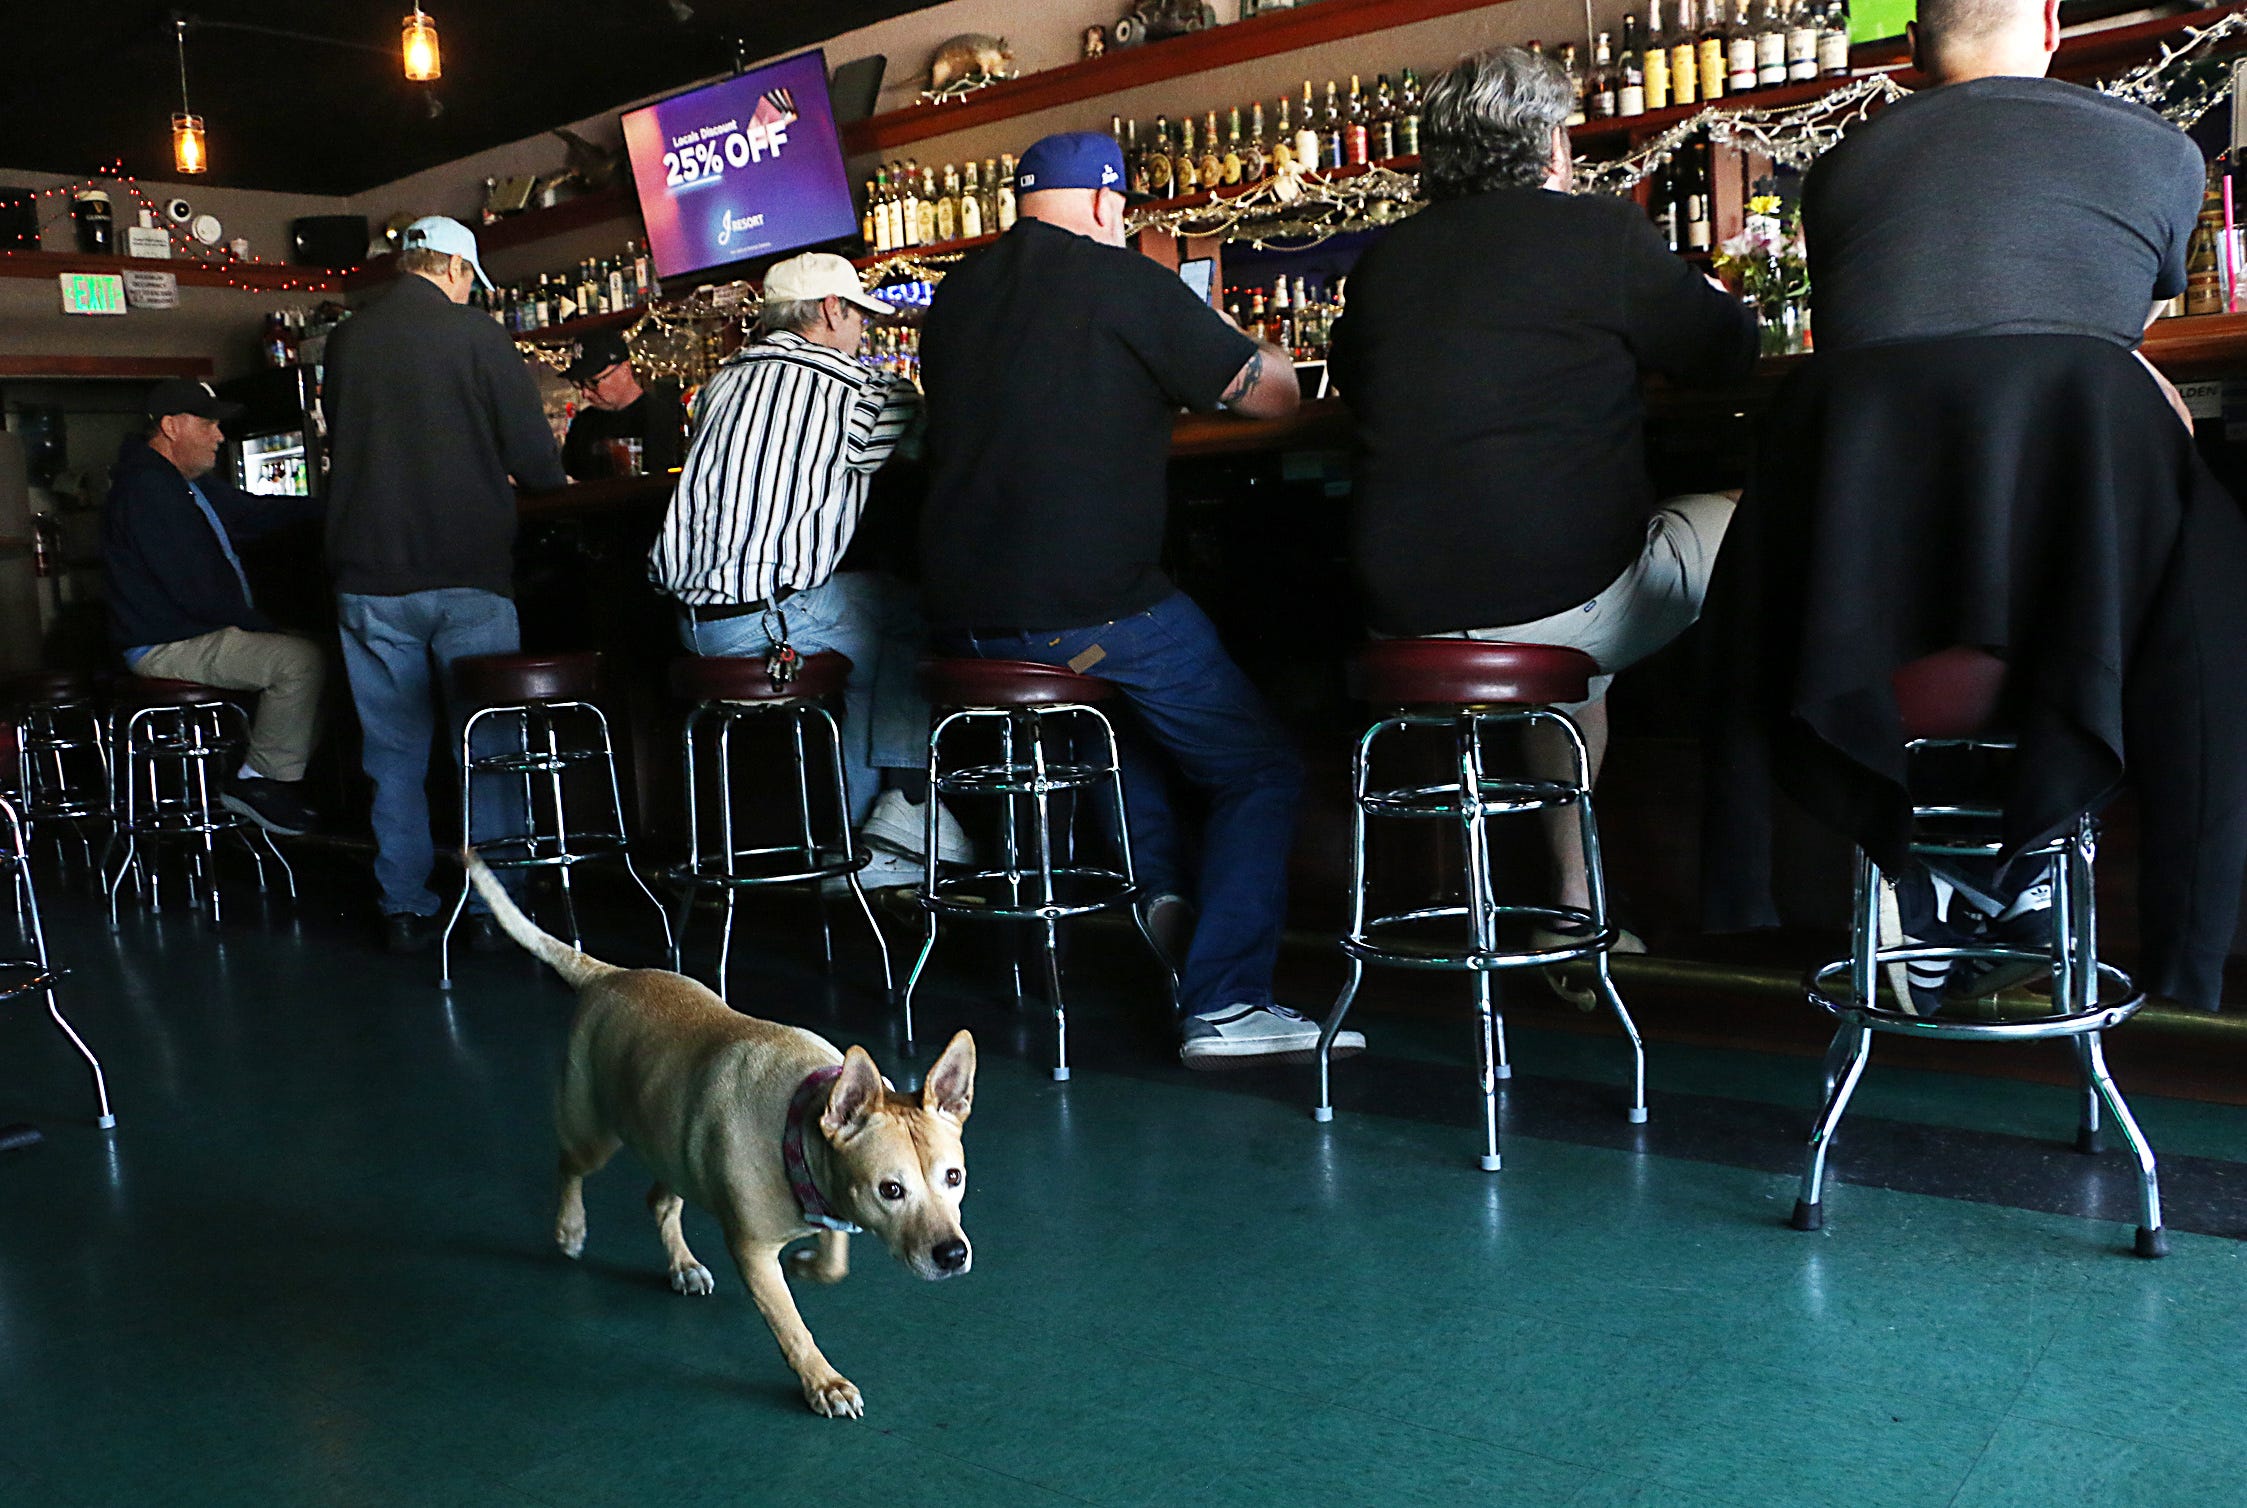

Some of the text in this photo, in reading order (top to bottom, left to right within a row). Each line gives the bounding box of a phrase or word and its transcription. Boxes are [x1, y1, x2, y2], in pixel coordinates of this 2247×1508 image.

[672, 119, 738, 148] Locals Discount
[662, 119, 788, 187] 25% OFF
[732, 213, 764, 232] RESORT
[73, 276, 116, 311] EXIT
[2180, 386, 2217, 398] LDEN
